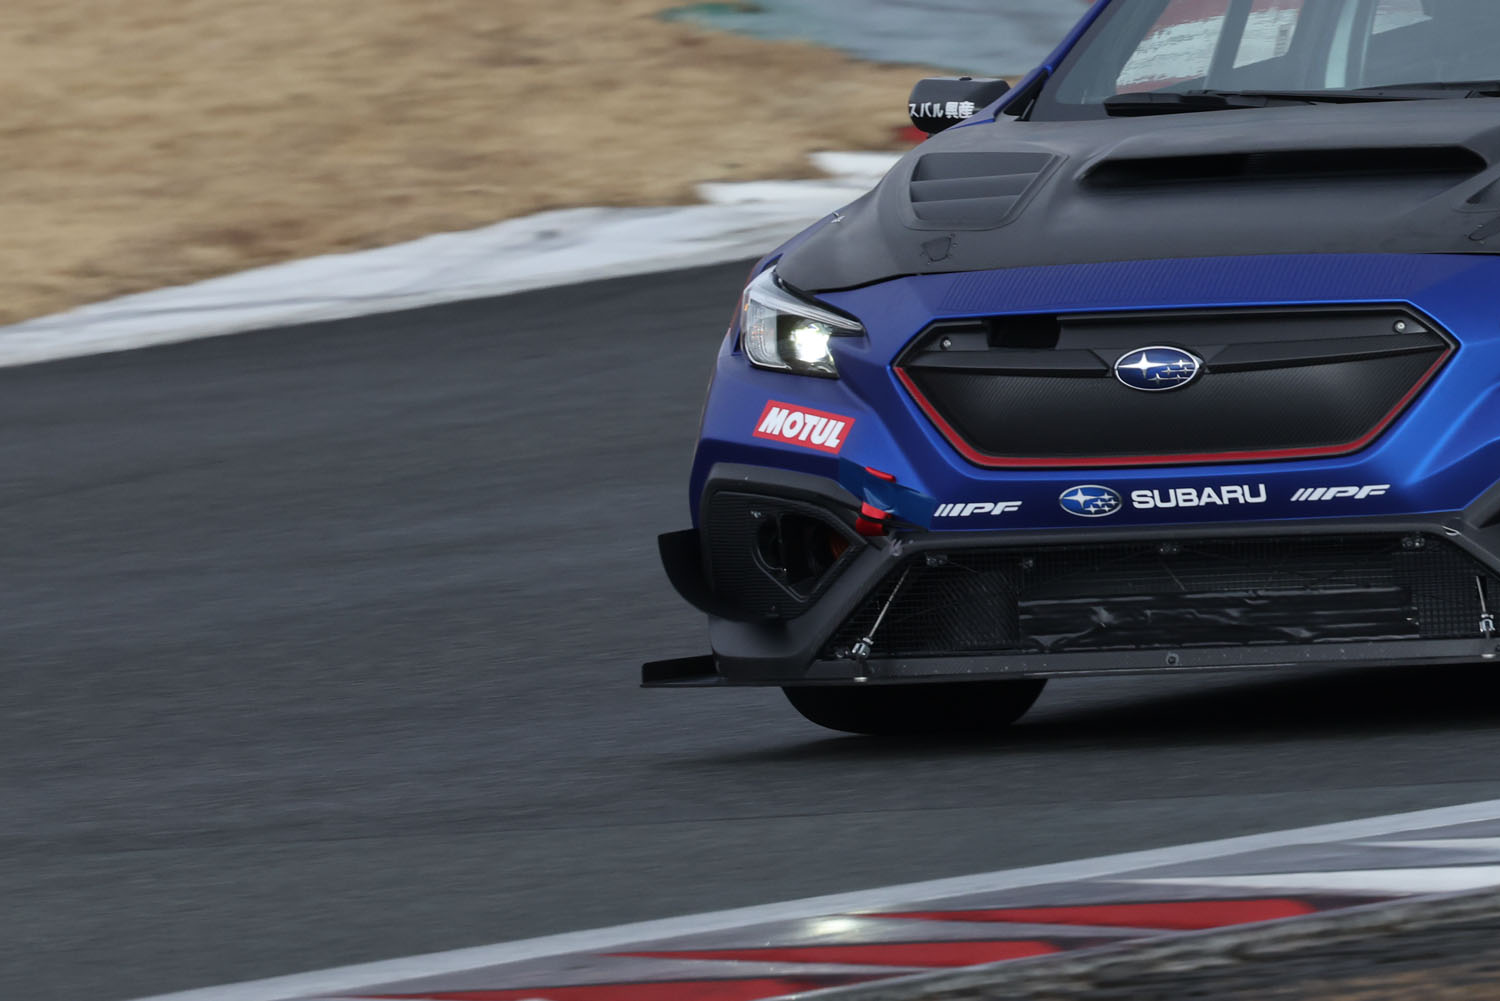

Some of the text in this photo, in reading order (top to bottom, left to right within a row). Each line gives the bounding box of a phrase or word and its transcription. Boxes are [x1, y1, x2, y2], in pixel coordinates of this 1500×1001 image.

[908, 101, 975, 119] スバル興産
[757, 404, 850, 449] MOTUL
[1131, 483, 1267, 510] SUBARU
